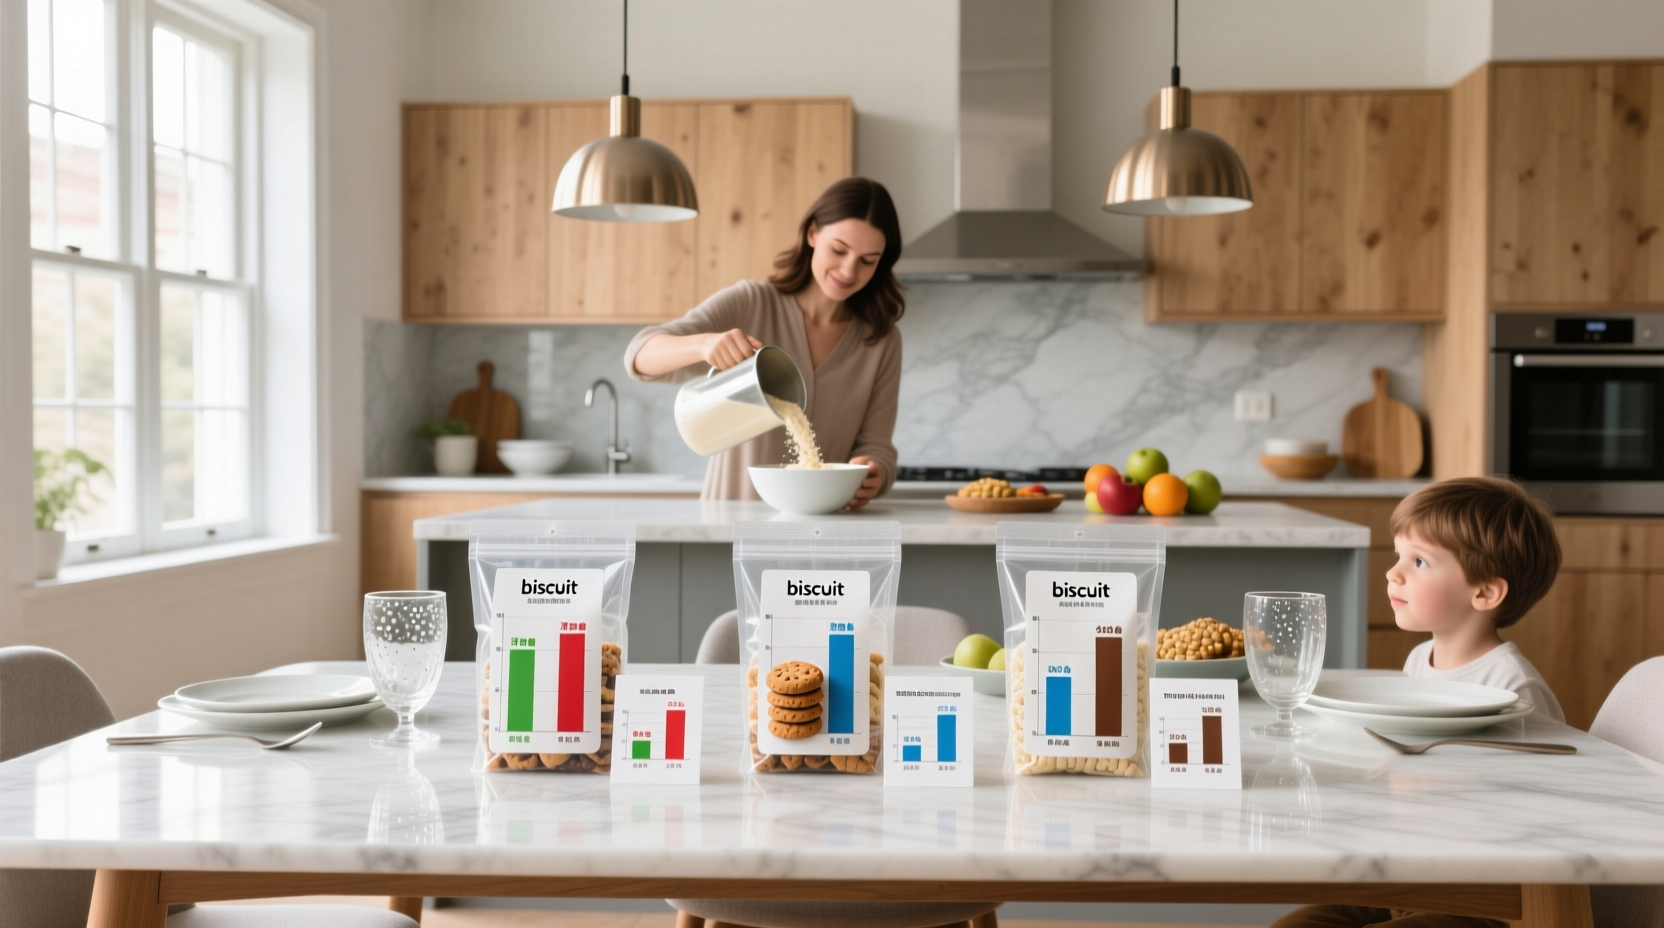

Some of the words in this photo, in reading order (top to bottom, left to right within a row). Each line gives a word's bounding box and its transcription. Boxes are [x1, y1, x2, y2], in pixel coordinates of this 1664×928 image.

[522, 579, 578, 594] biscuit
[788, 580, 844, 596] biscuit
[1053, 582, 1110, 598] biscuit
